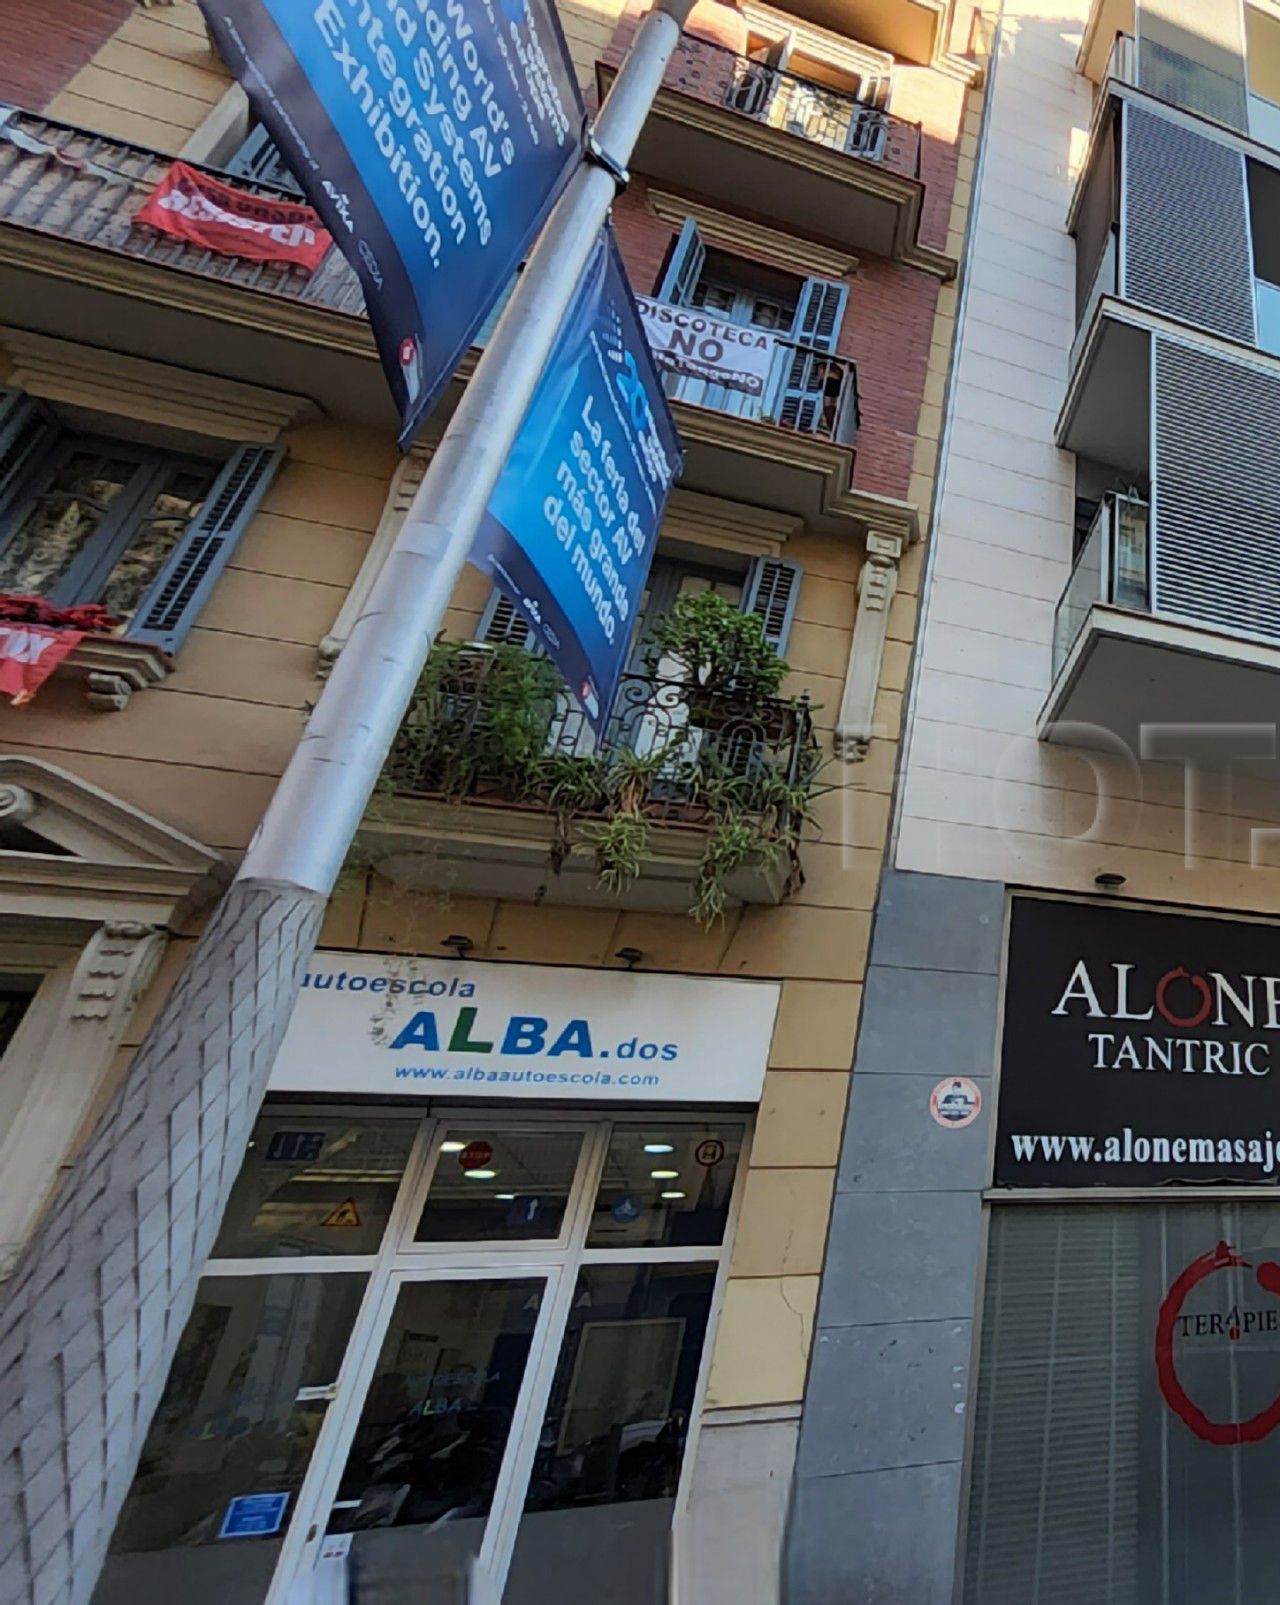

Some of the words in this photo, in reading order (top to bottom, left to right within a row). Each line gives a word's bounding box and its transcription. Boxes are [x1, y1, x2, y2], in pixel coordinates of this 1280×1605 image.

[314, 0, 442, 269] Exhibition.
[347, 0, 467, 244] ntegration
[413, 47, 492, 247] Systems
[415, 0, 471, 122] ding
[470, 125, 501, 178] AV
[446, 0, 514, 165] World's
[636, 299, 768, 350] DISCOTECA
[668, 329, 724, 363] NO
[557, 460, 592, 532] más
[588, 528, 629, 622] grande
[570, 430, 616, 528] sector
[612, 526, 633, 565] AV
[582, 395, 602, 447] La
[601, 440, 629, 515] feria
[627, 510, 646, 557] del
[544, 495, 577, 551] del
[572, 544, 615, 645] mundo.
[301, 970, 476, 999] utoescola
[1088, 1033, 1270, 1076] TANTRIC
[395, 1065, 660, 1087] www.albaautoescola.com
